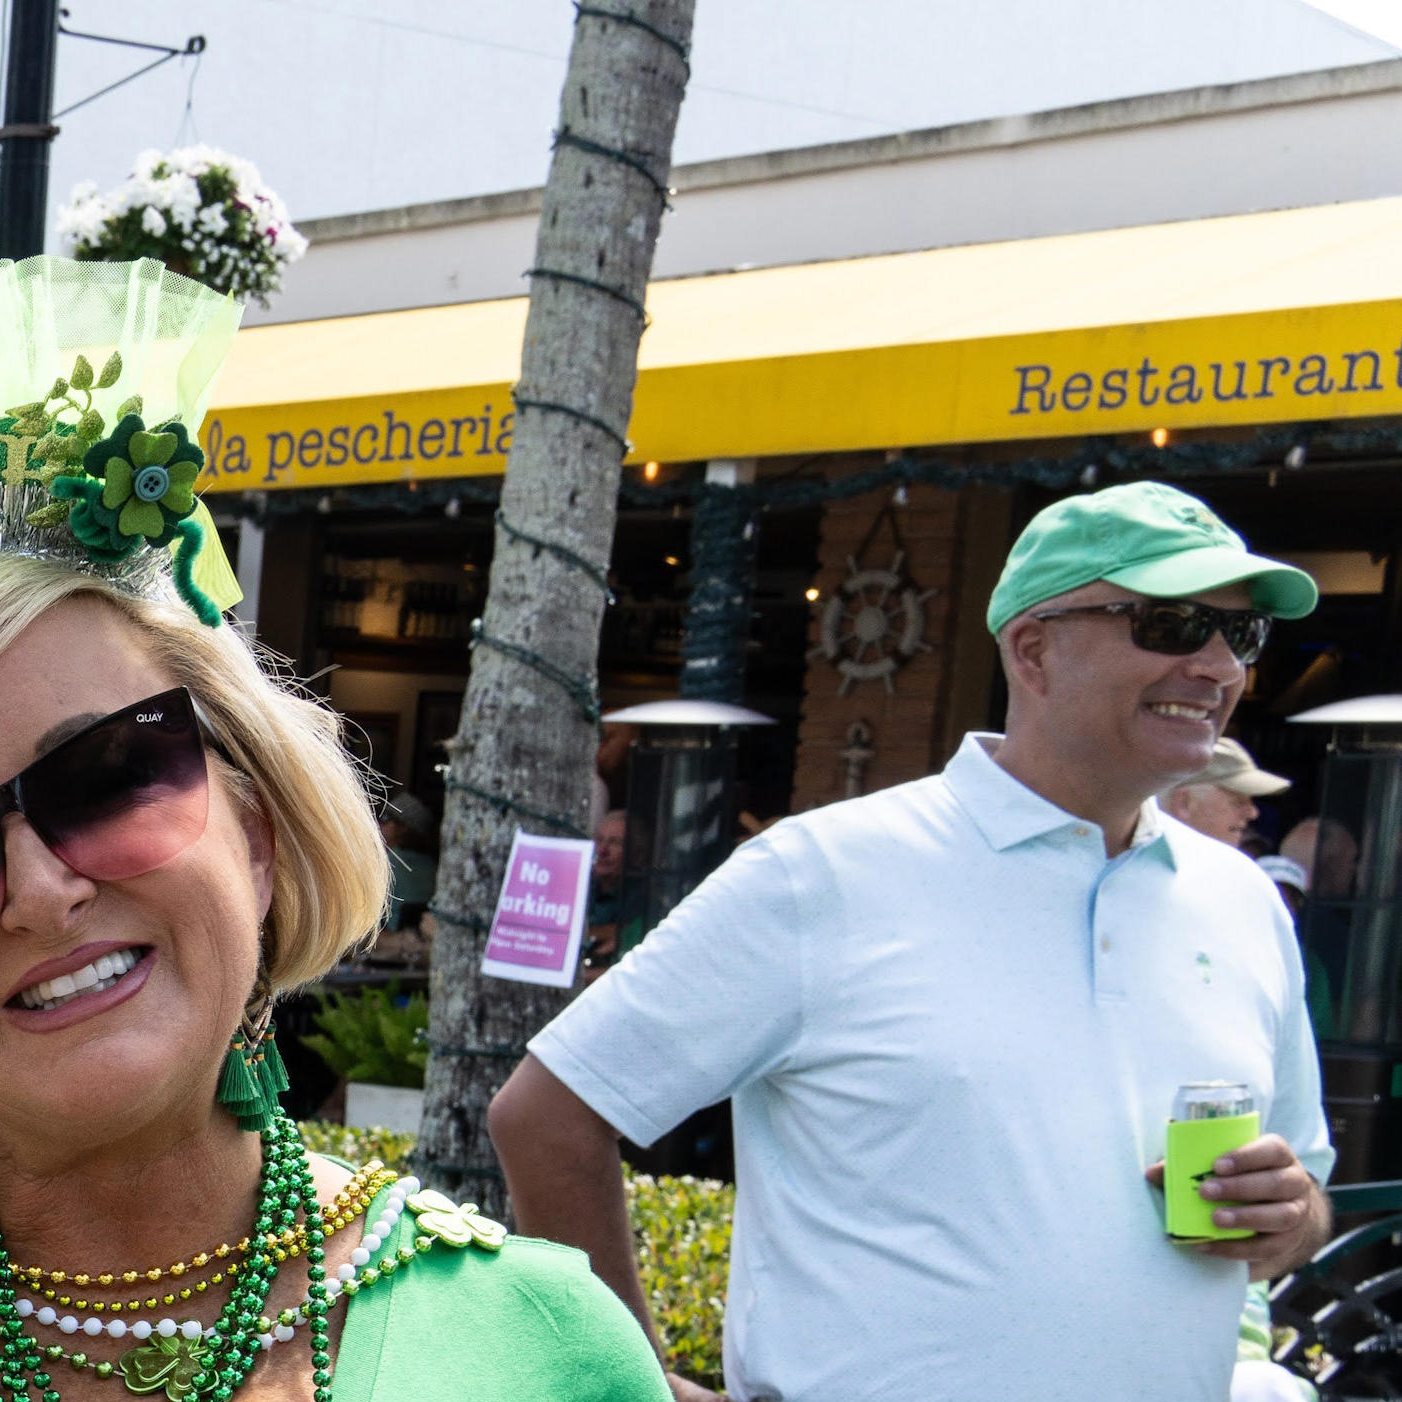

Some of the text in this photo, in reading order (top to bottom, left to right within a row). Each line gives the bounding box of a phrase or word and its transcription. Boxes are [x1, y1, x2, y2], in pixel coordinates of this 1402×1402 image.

[203, 404, 515, 483] la pescheria
[136, 712, 164, 723] QUAY
[520, 860, 551, 886] No
[499, 892, 570, 926] arking
